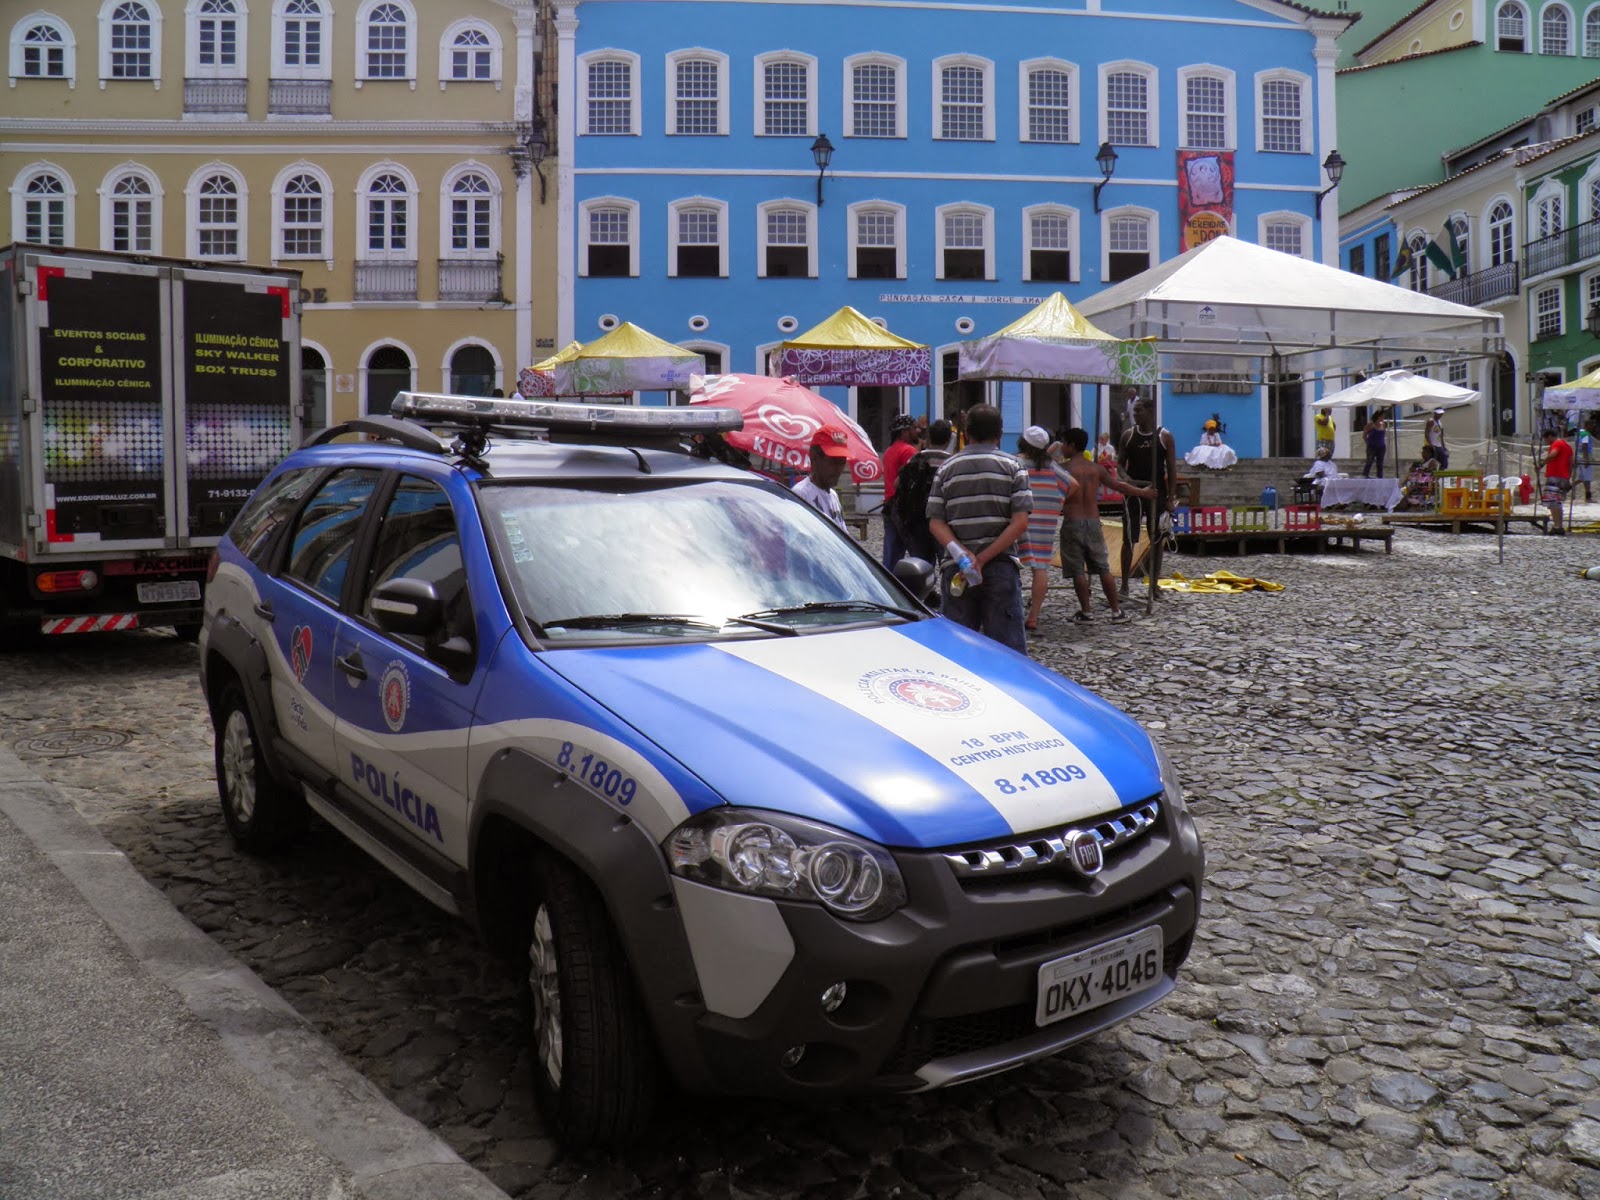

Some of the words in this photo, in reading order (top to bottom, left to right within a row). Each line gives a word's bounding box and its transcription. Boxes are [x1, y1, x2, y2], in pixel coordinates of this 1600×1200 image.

[54, 329, 103, 339] EVENTOS
[105, 331, 146, 341] SOCIAIS
[195, 332, 248, 348] ILUMINAÇÃO
[249, 335, 279, 349] CÊNICA
[94, 345, 103, 354] &
[195, 349, 222, 358] SKY
[225, 351, 280, 362] WALKER
[58, 357, 146, 369] CORPORATIVO
[195, 365, 226, 374] BOX
[229, 366, 277, 377] TRUSS
[55, 378, 115, 388] ILUMINAÇÃO
[117, 379, 151, 388] CÊNICA
[881, 374, 908, 385] FLOR
[960, 738, 984, 750] 18
[989, 730, 1030, 743] BPM
[950, 749, 1003, 767] CENTRO
[1003, 738, 1065, 757] HISTÓRICO
[557, 741, 638, 806] 8.1809
[994, 764, 1087, 795] 8.1809
[350, 752, 444, 843] POLÍCIA
[1078, 843, 1098, 866] FIAT
